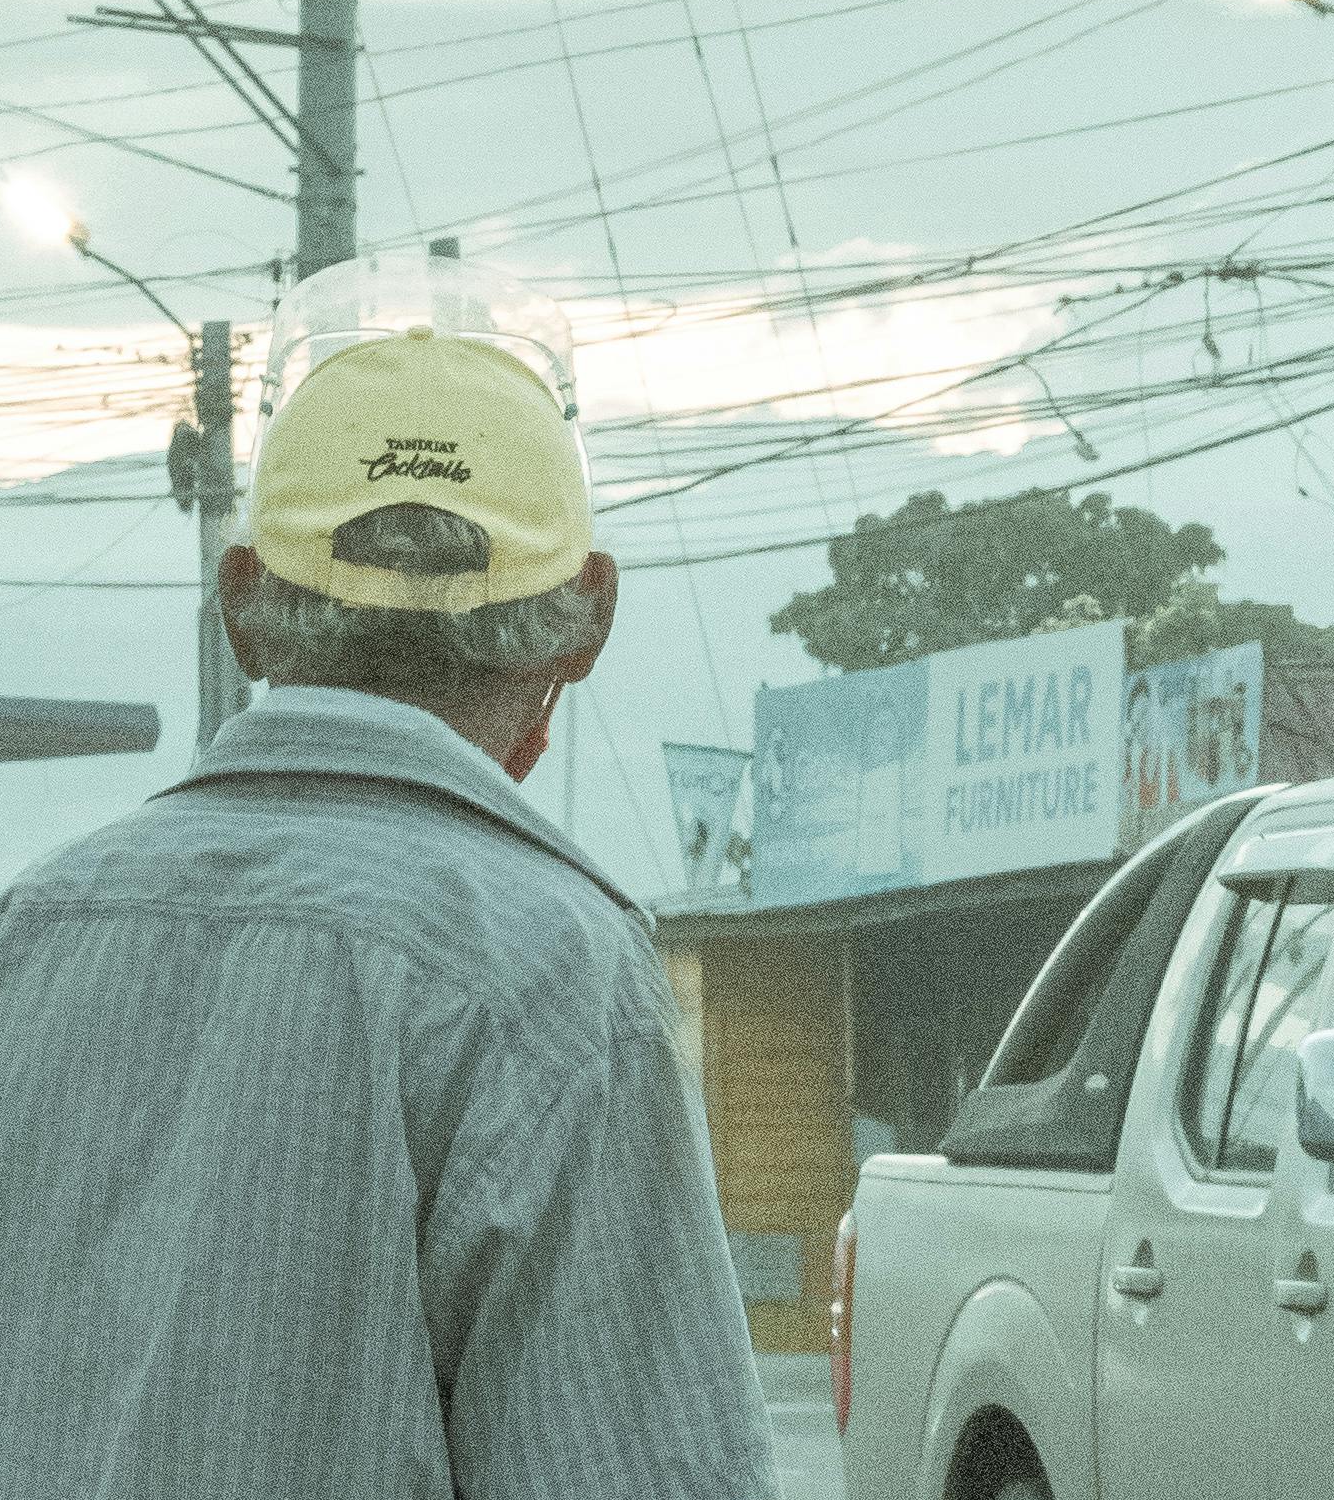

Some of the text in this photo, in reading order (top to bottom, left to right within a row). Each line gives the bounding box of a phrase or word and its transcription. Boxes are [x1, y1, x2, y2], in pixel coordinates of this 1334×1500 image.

[385, 437, 459, 453] TANDUAY
[954, 667, 1091, 765] LEMAR
[943, 760, 1099, 835] FURNITURE
